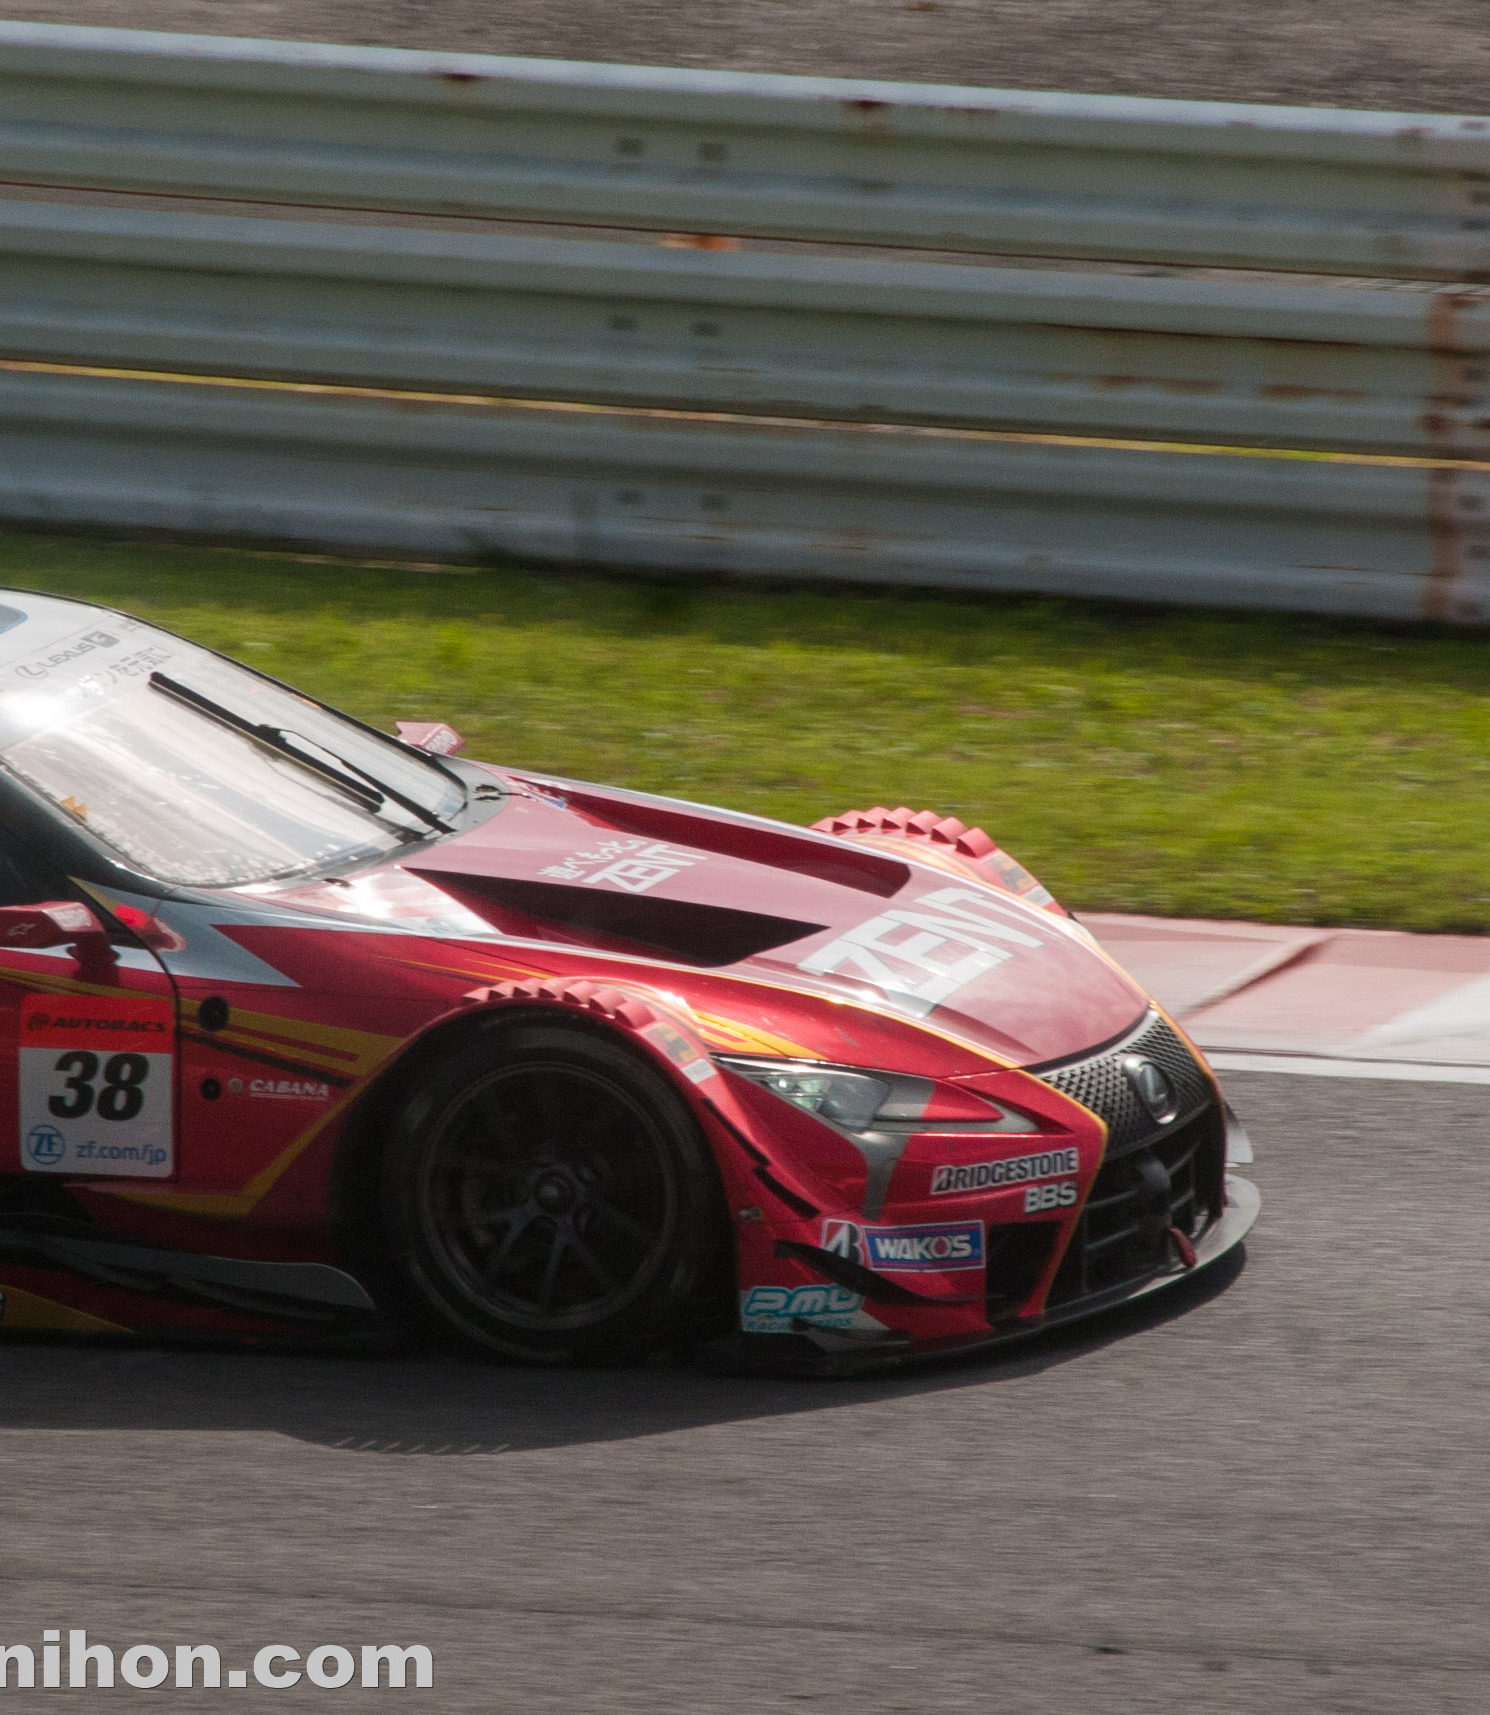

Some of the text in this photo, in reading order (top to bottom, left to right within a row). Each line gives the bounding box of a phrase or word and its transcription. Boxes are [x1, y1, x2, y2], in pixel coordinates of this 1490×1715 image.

[53, 1015, 167, 1034] AUTOBACS
[47, 1049, 150, 1122] 38
[249, 1079, 330, 1098] CABANA
[29, 1130, 64, 1160] ZF
[75, 1141, 167, 1165] zf.com/jp
[932, 1149, 1078, 1194] BRIDGESTONE
[1024, 1181, 1078, 1214] BBS
